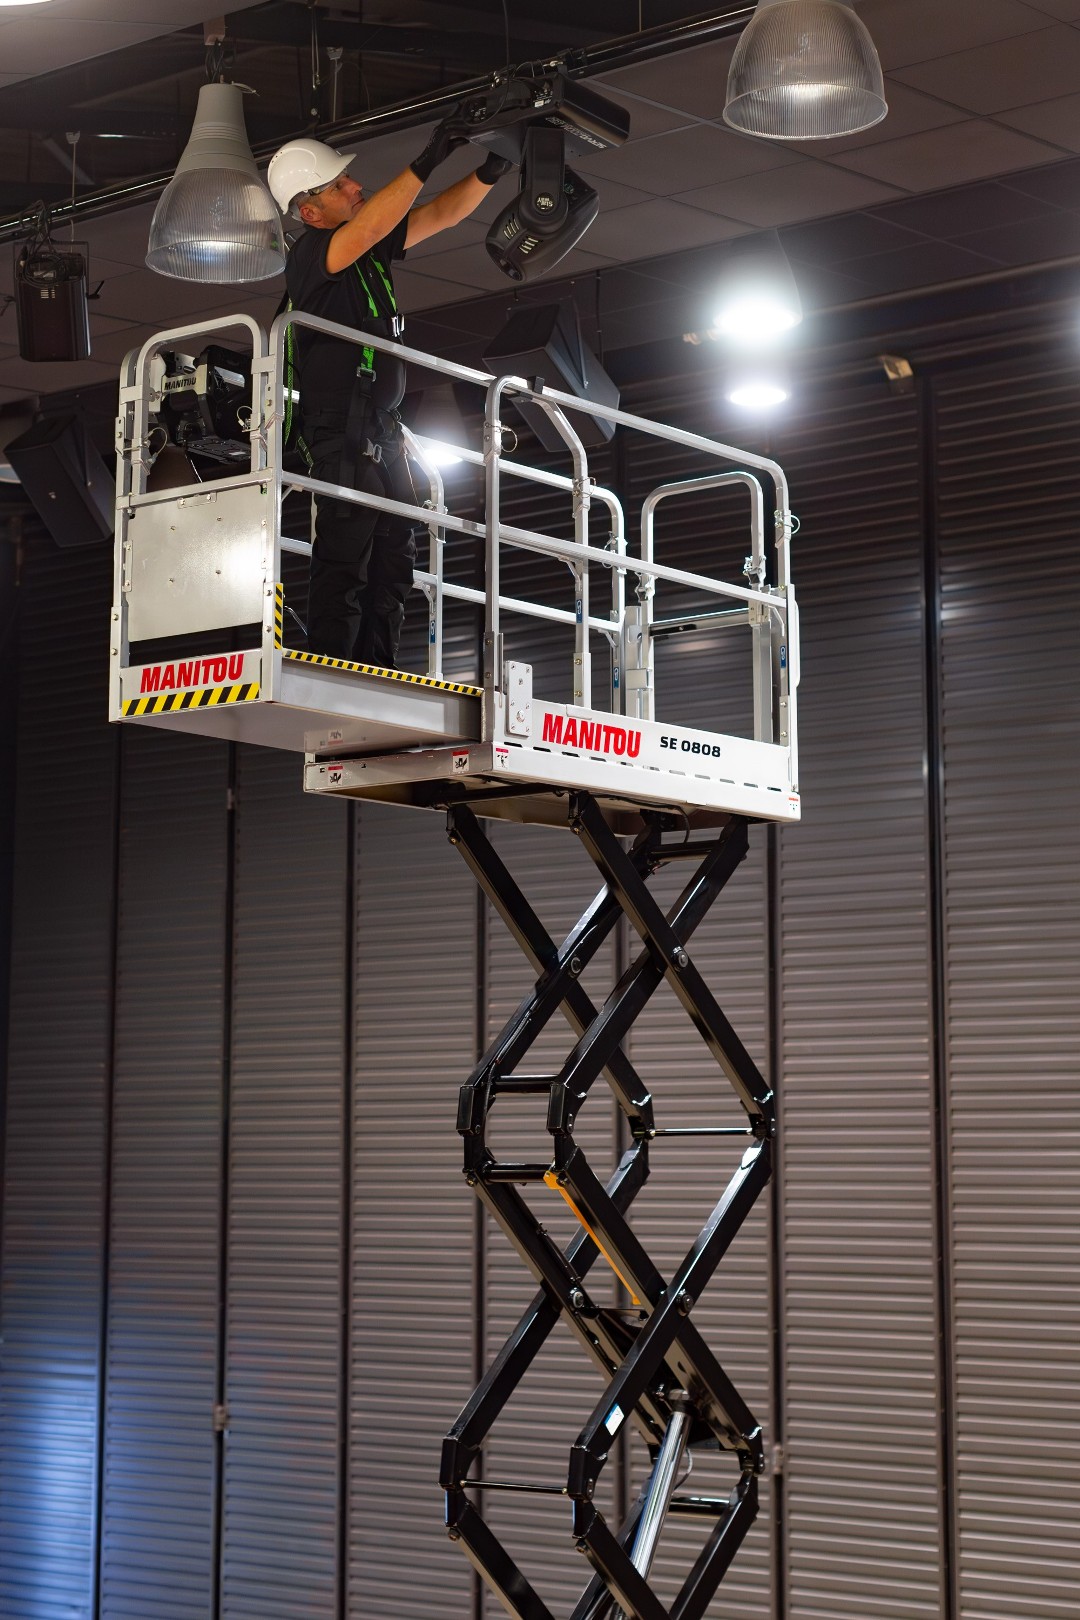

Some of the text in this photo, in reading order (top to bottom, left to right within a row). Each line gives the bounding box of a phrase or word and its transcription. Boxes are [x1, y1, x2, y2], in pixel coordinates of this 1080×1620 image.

[164, 377, 197, 390] MANITOU
[140, 654, 244, 693] MANITOU
[542, 713, 721, 758] MANITOU SE 0808
